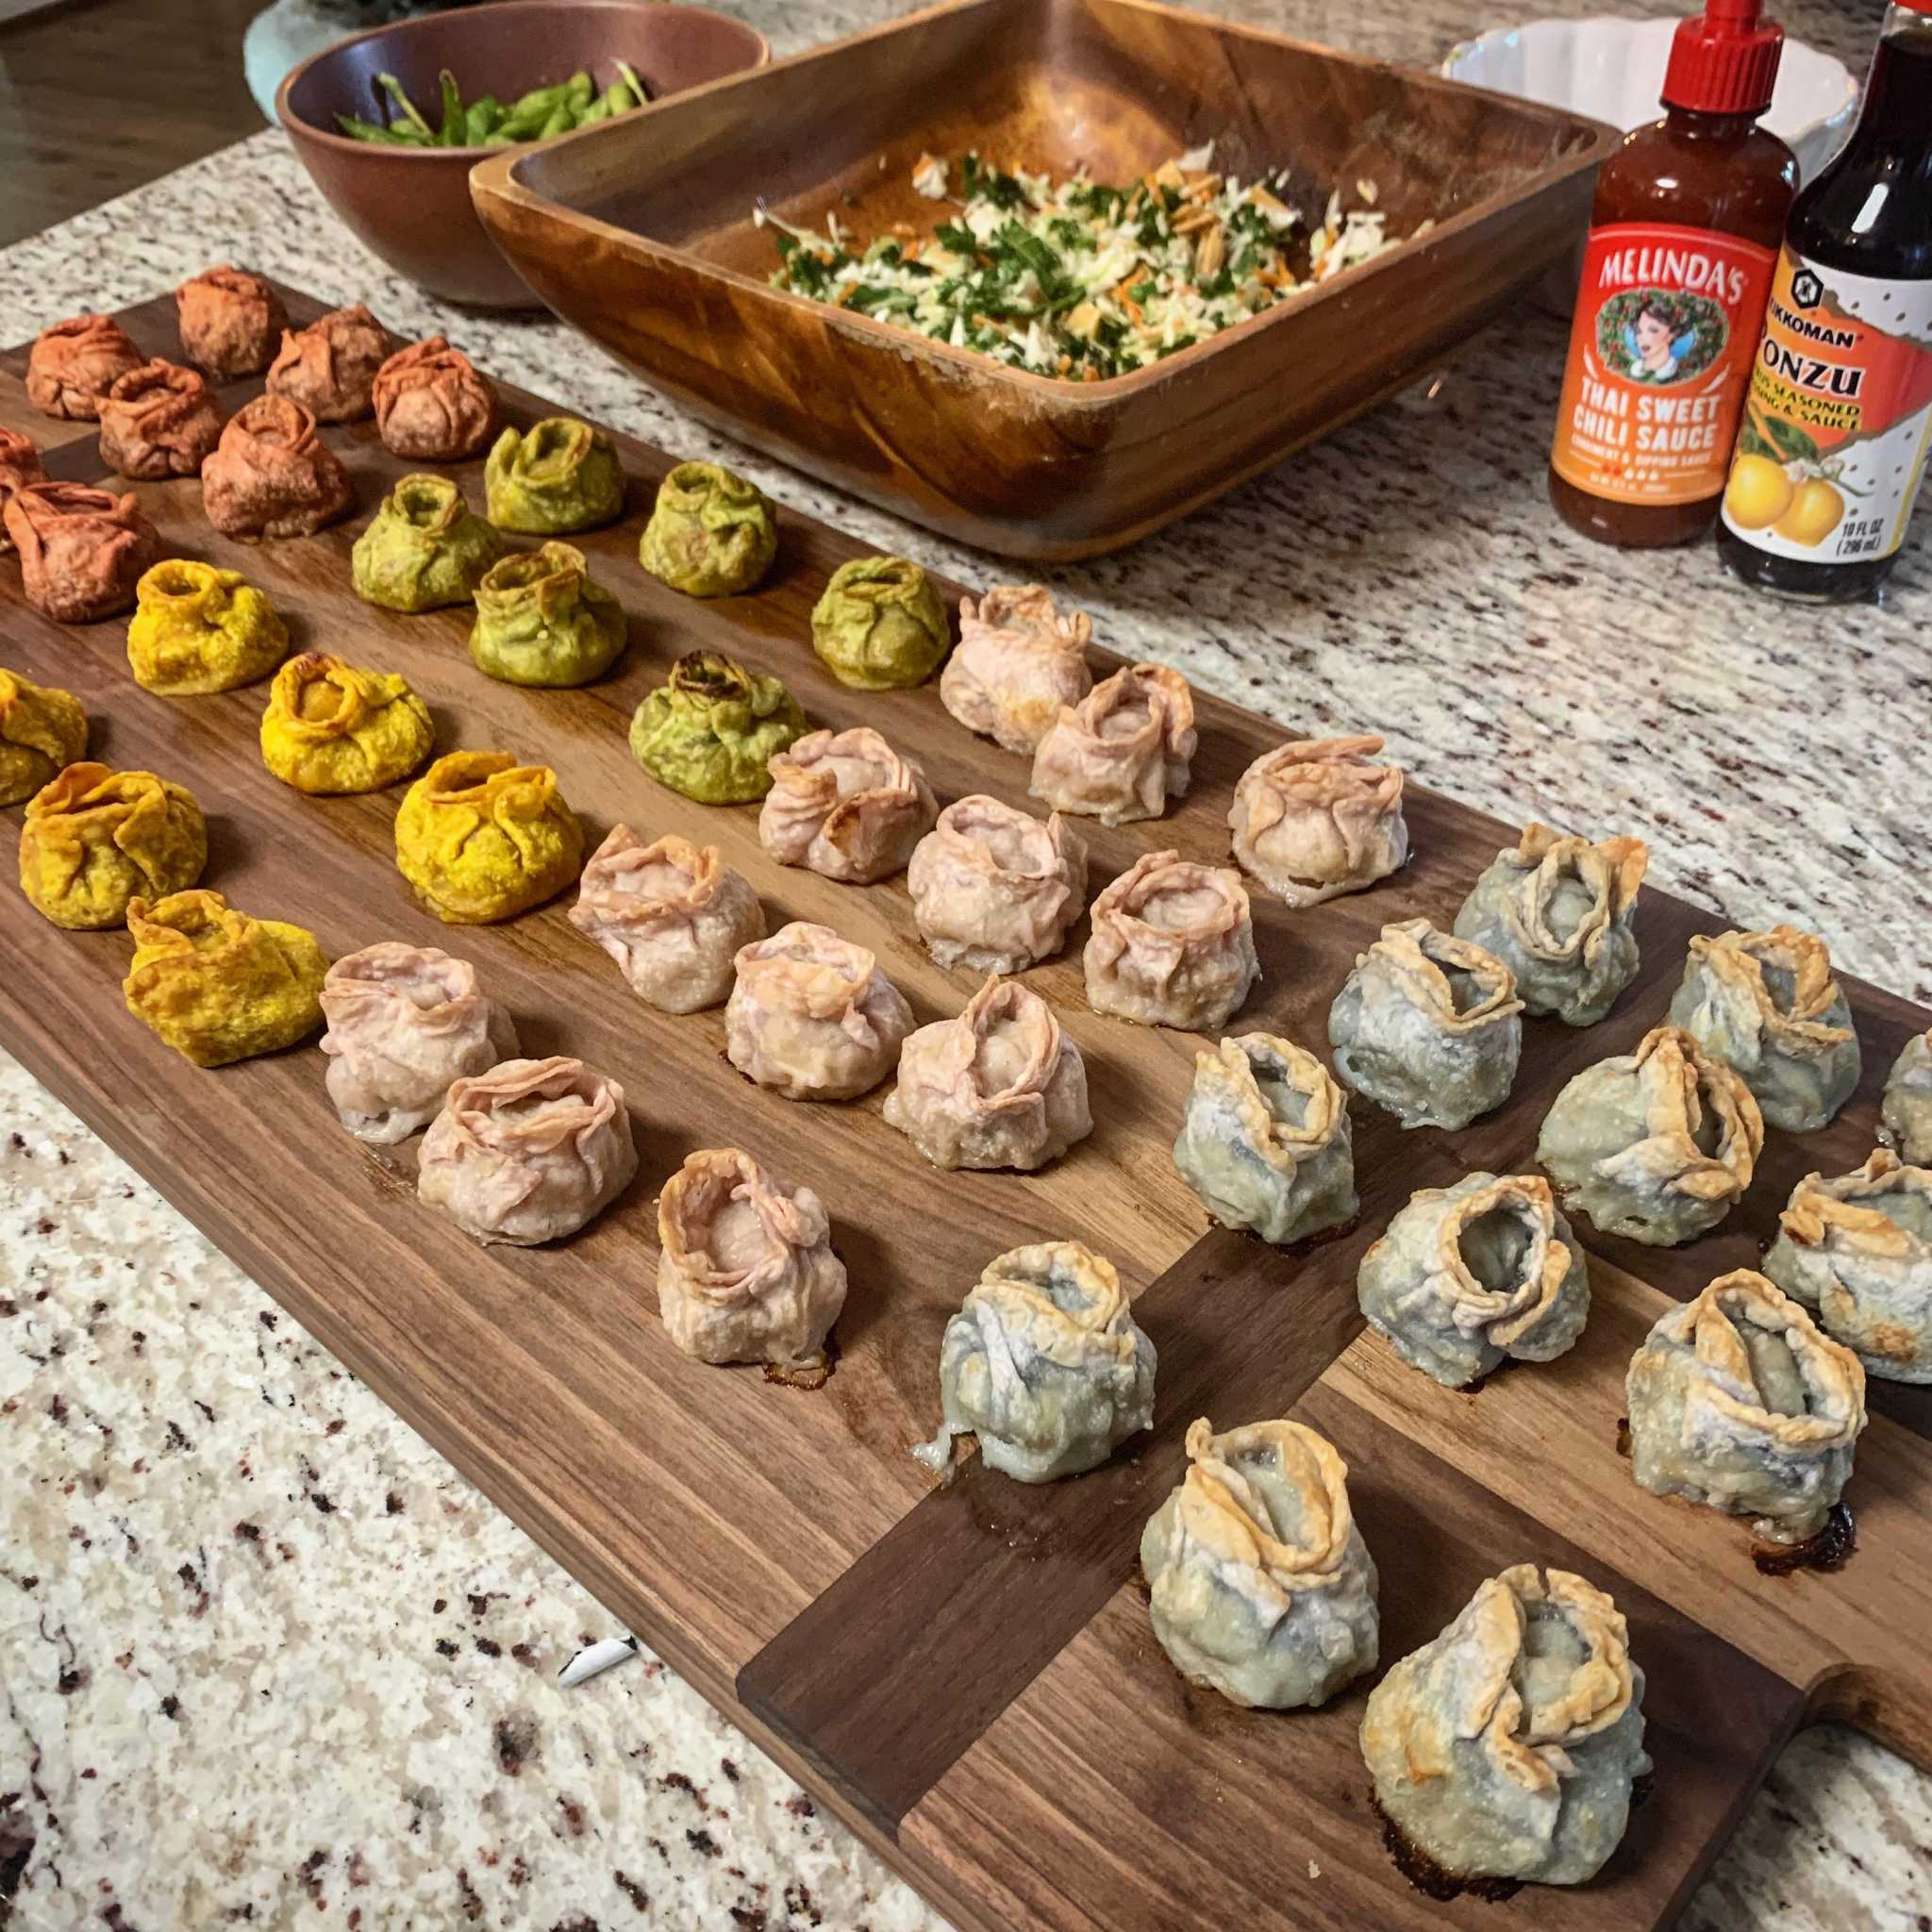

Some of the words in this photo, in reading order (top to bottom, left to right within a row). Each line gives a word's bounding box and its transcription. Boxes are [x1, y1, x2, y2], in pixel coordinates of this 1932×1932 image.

[1598, 247, 1743, 305] MELINDA'S
[1771, 299, 1854, 348] IKKOMAN
[1763, 338, 1861, 396] ONZU
[1581, 375, 1629, 418] THAI
[1635, 394, 1721, 424] SWEET
[1774, 383, 1860, 416] SEASONED
[1800, 410, 1857, 431] SAUCE
[1573, 403, 1628, 447] CHILI
[1635, 423, 1718, 453] SAUCE
[1842, 522, 1856, 537] 10
